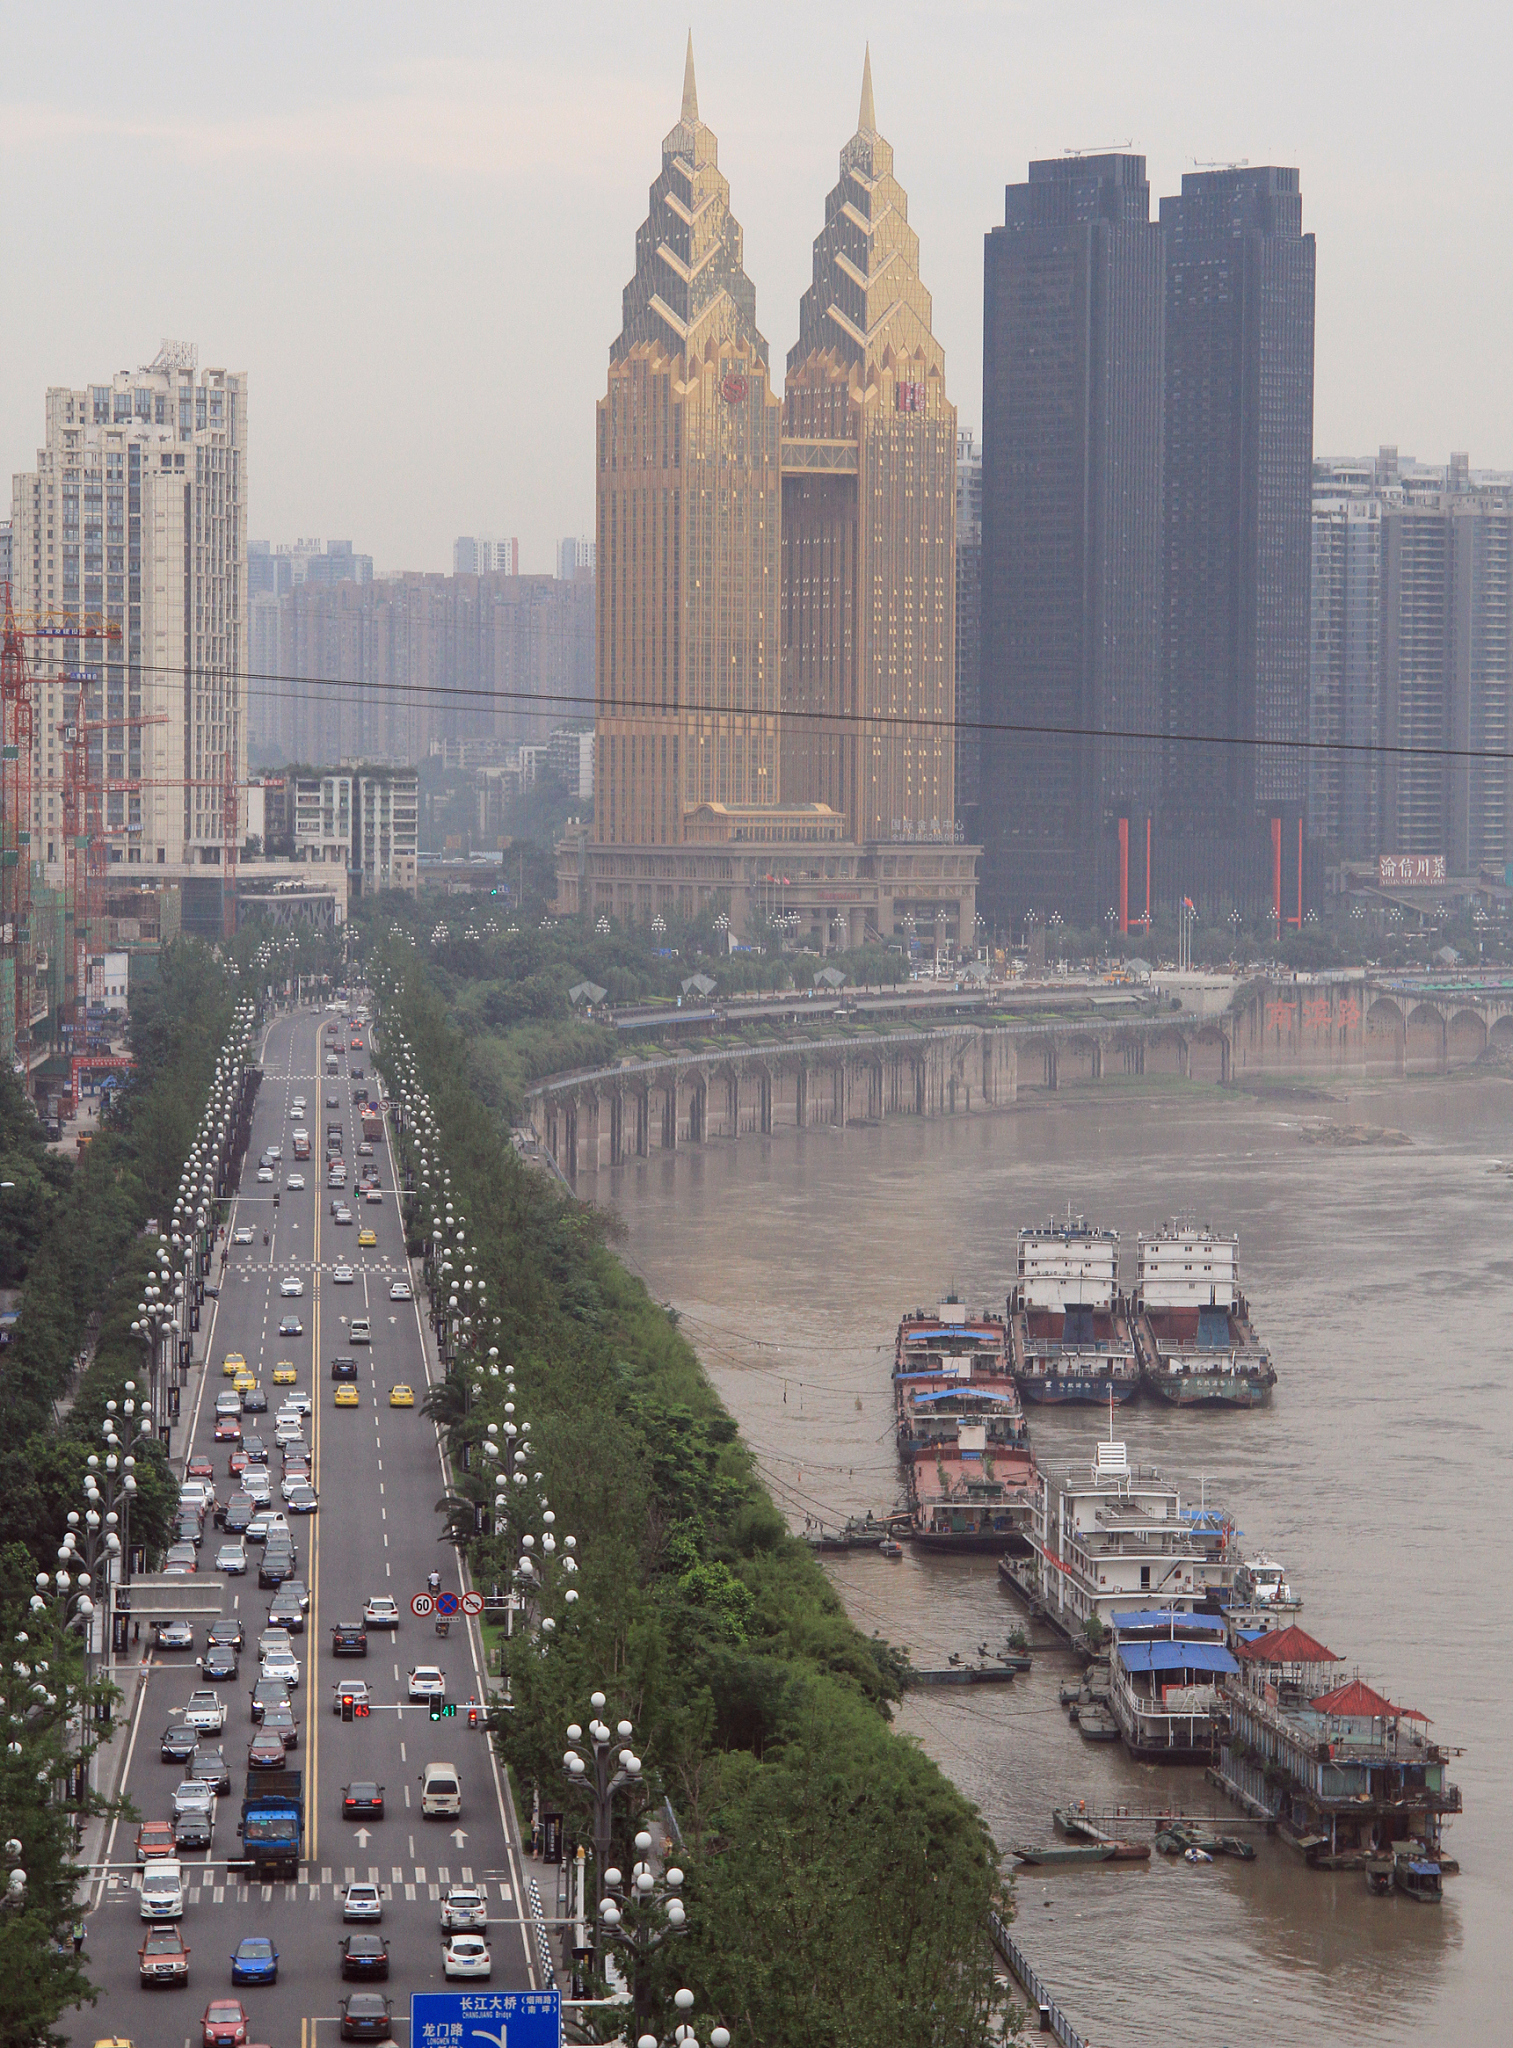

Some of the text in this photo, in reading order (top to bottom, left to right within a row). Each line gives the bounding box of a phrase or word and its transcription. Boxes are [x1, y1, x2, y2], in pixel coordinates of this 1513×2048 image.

[1380, 856, 1445, 878] 渝信川菜
[1266, 997, 1361, 1031] 南滨路
[416, 1598, 429, 1611] 60
[355, 1704, 369, 1717] 43
[442, 1705, 455, 1717] 41
[459, 1996, 517, 2011] 长江大桥
[462, 2010, 512, 2020] CHANGJIANG Bridge
[422, 2022, 463, 2037] 龙门路
